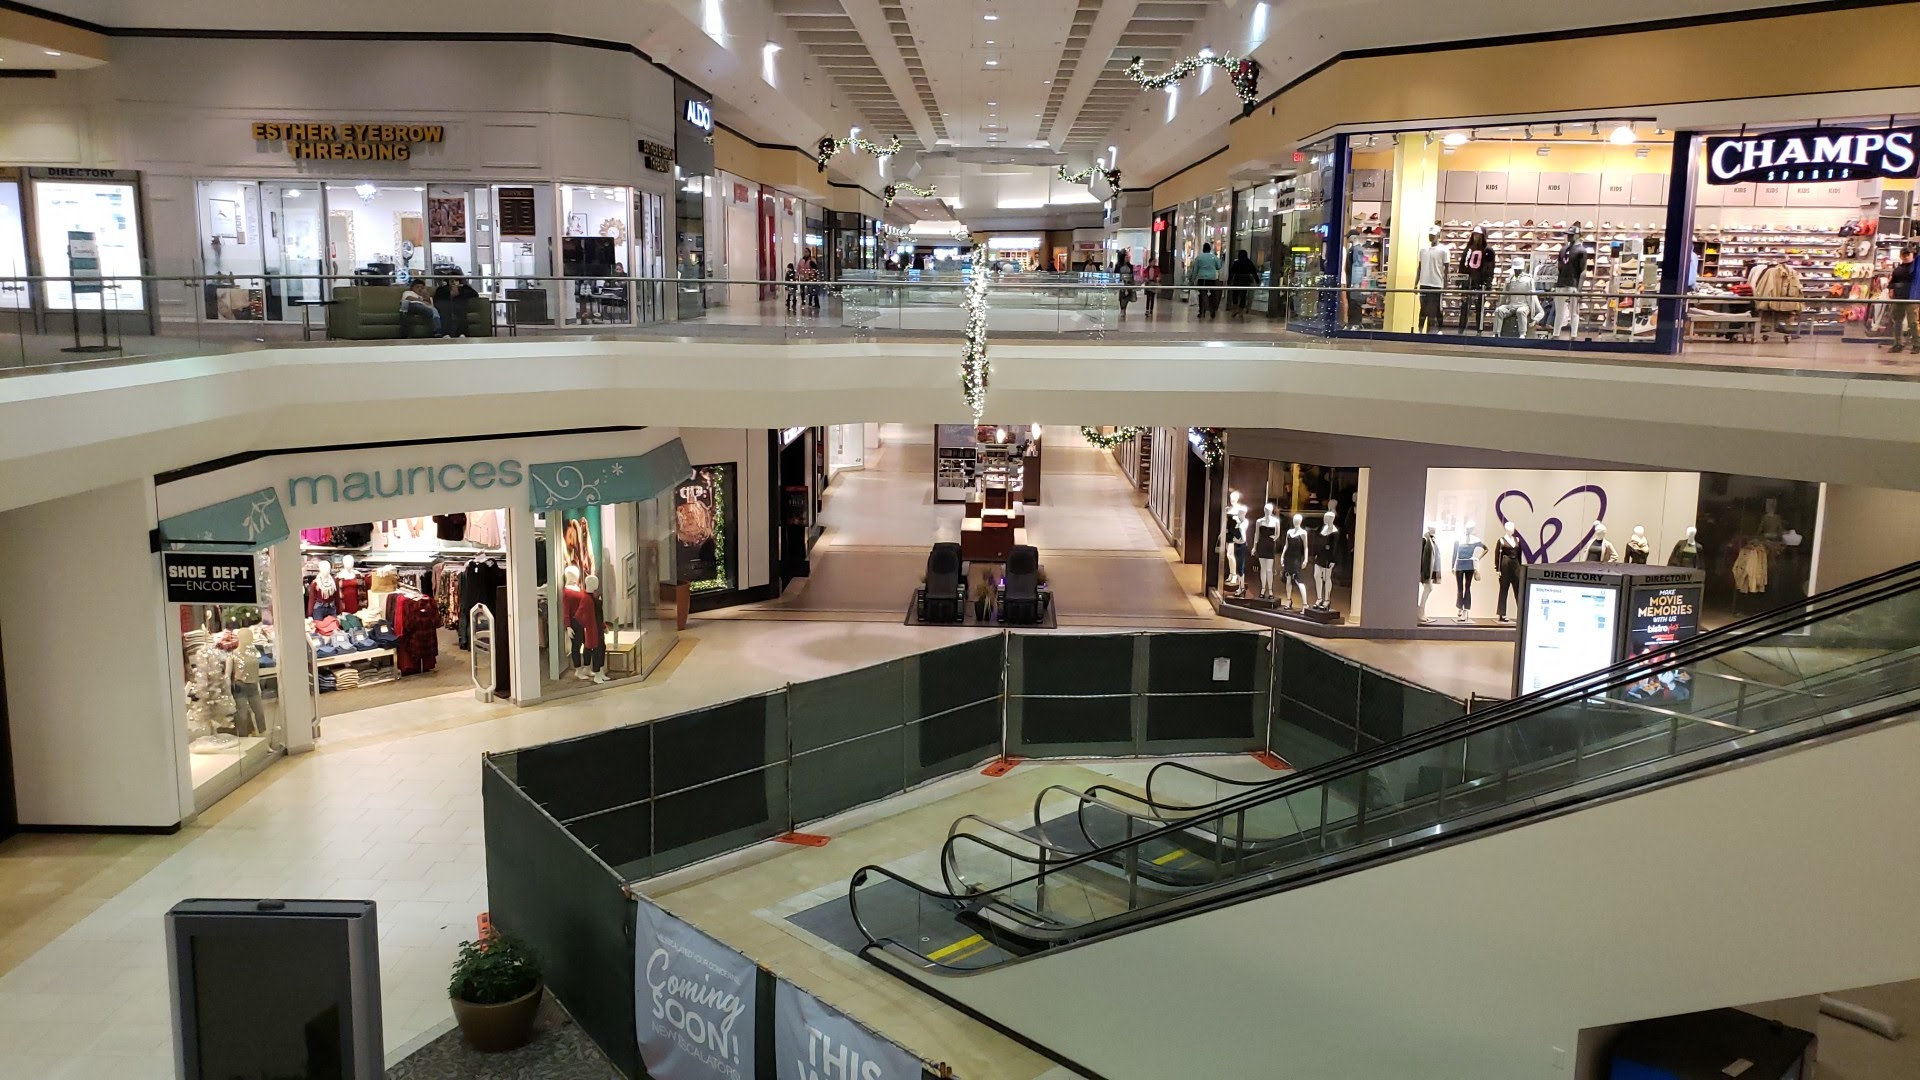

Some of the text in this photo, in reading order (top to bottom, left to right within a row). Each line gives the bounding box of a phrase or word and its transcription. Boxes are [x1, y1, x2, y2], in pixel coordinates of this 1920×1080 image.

[687, 100, 710, 130] ALDO
[252, 123, 444, 142] ESTHER EYEBROW
[287, 141, 410, 160] THREADING
[1711, 132, 1915, 179] CHAMPS
[48, 167, 115, 177] DIRECTORY
[1767, 169, 1849, 181] SPORTS
[289, 459, 524, 506] maurices
[168, 565, 249, 579] SHOE DEPT
[1543, 570, 1604, 581] DIRECTORY
[1645, 574, 1693, 583] DIRECTORY
[186, 581, 236, 592] ENCORE
[1649, 595, 1683, 606] MOVIE
[1638, 605, 1693, 617] MEMORIES
[646, 948, 746, 1033] Coming
[652, 990, 740, 1065] SOON!
[652, 1021, 677, 1041] NEW
